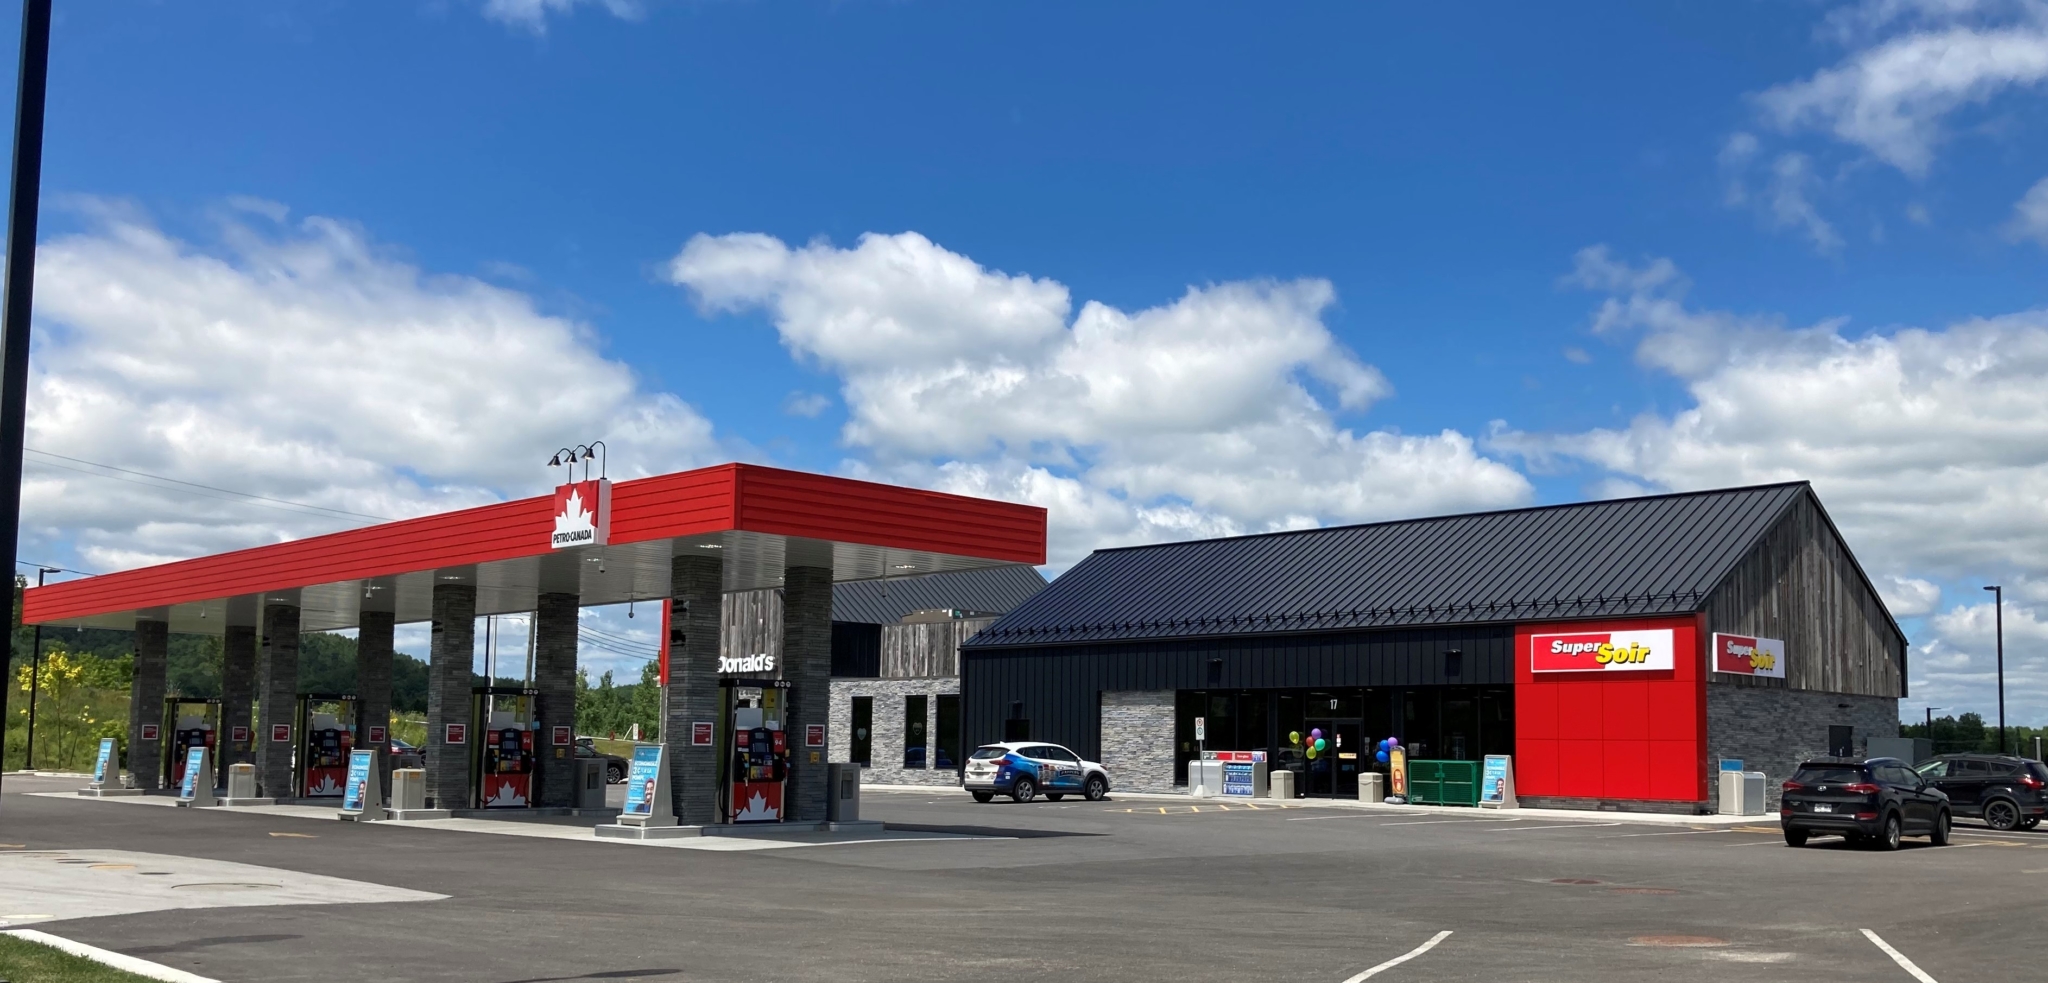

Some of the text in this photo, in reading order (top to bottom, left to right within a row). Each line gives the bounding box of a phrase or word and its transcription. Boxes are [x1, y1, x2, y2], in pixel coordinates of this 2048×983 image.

[1551, 639, 1651, 665] Super Soir
[1726, 640, 1776, 671] Super Soir
[1329, 699, 1338, 710] 17
